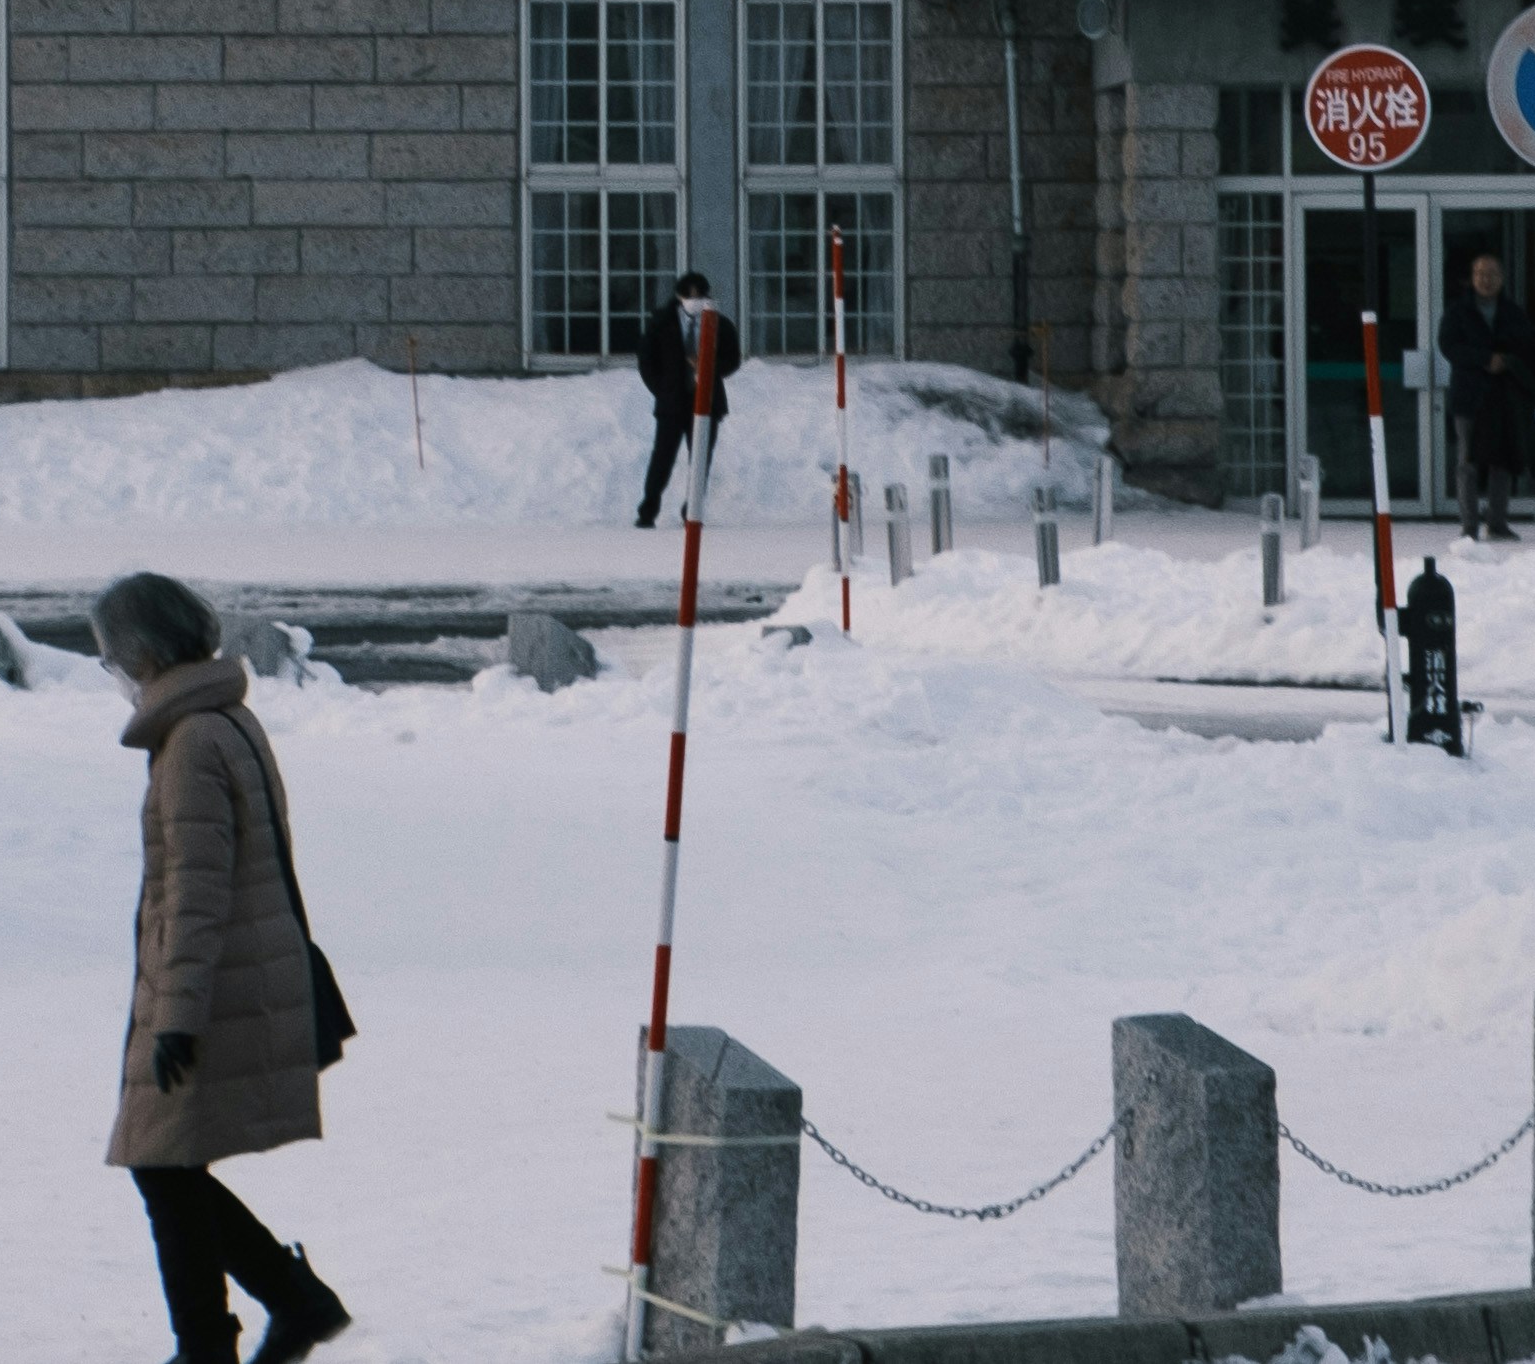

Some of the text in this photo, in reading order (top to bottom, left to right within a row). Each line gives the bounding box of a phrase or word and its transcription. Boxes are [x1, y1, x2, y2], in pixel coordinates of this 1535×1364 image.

[1325, 65, 1405, 83] FIRE HYDRANT
[1316, 83, 1420, 132] 消火栓
[1348, 131, 1387, 162] 95
